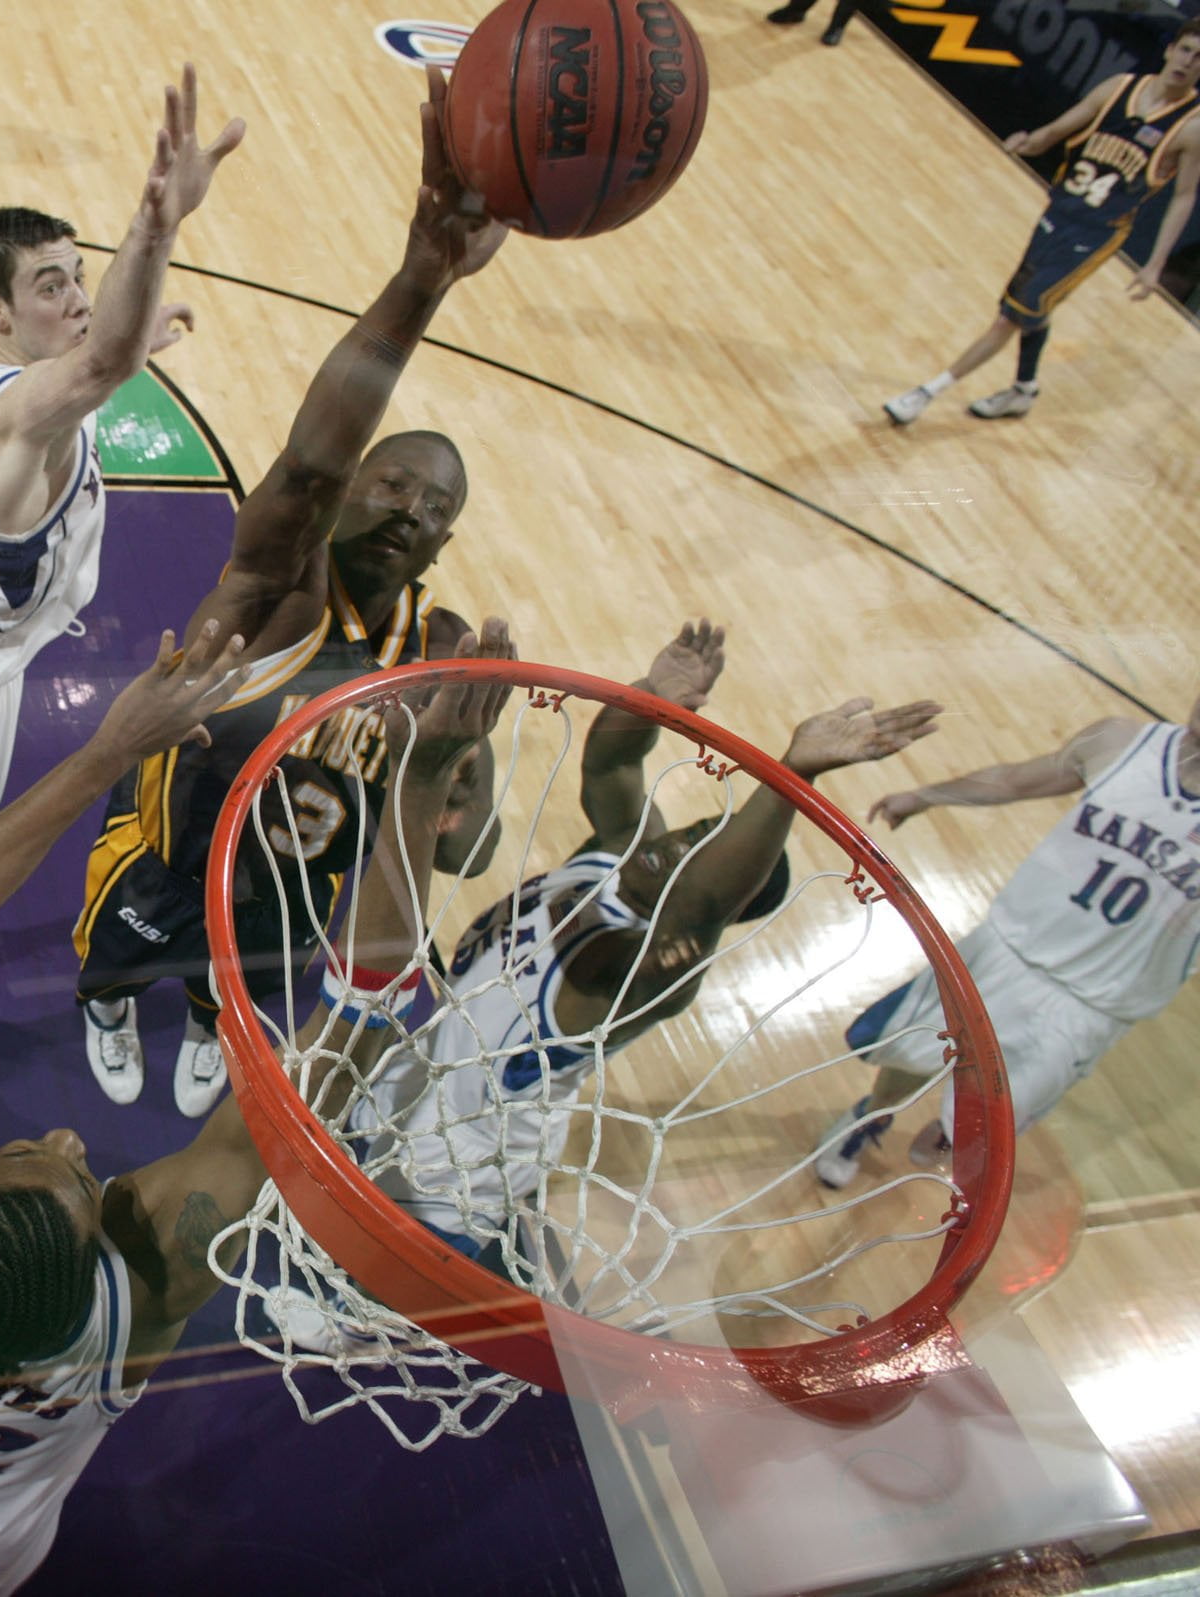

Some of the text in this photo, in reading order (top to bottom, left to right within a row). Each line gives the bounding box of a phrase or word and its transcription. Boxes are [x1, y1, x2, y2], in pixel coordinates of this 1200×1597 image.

[547, 26, 592, 160] NCAA
[627, 1, 687, 182] Wilson
[1064, 159, 1120, 208] 34
[268, 781, 348, 861] 3
[1069, 858, 1150, 926] 10
